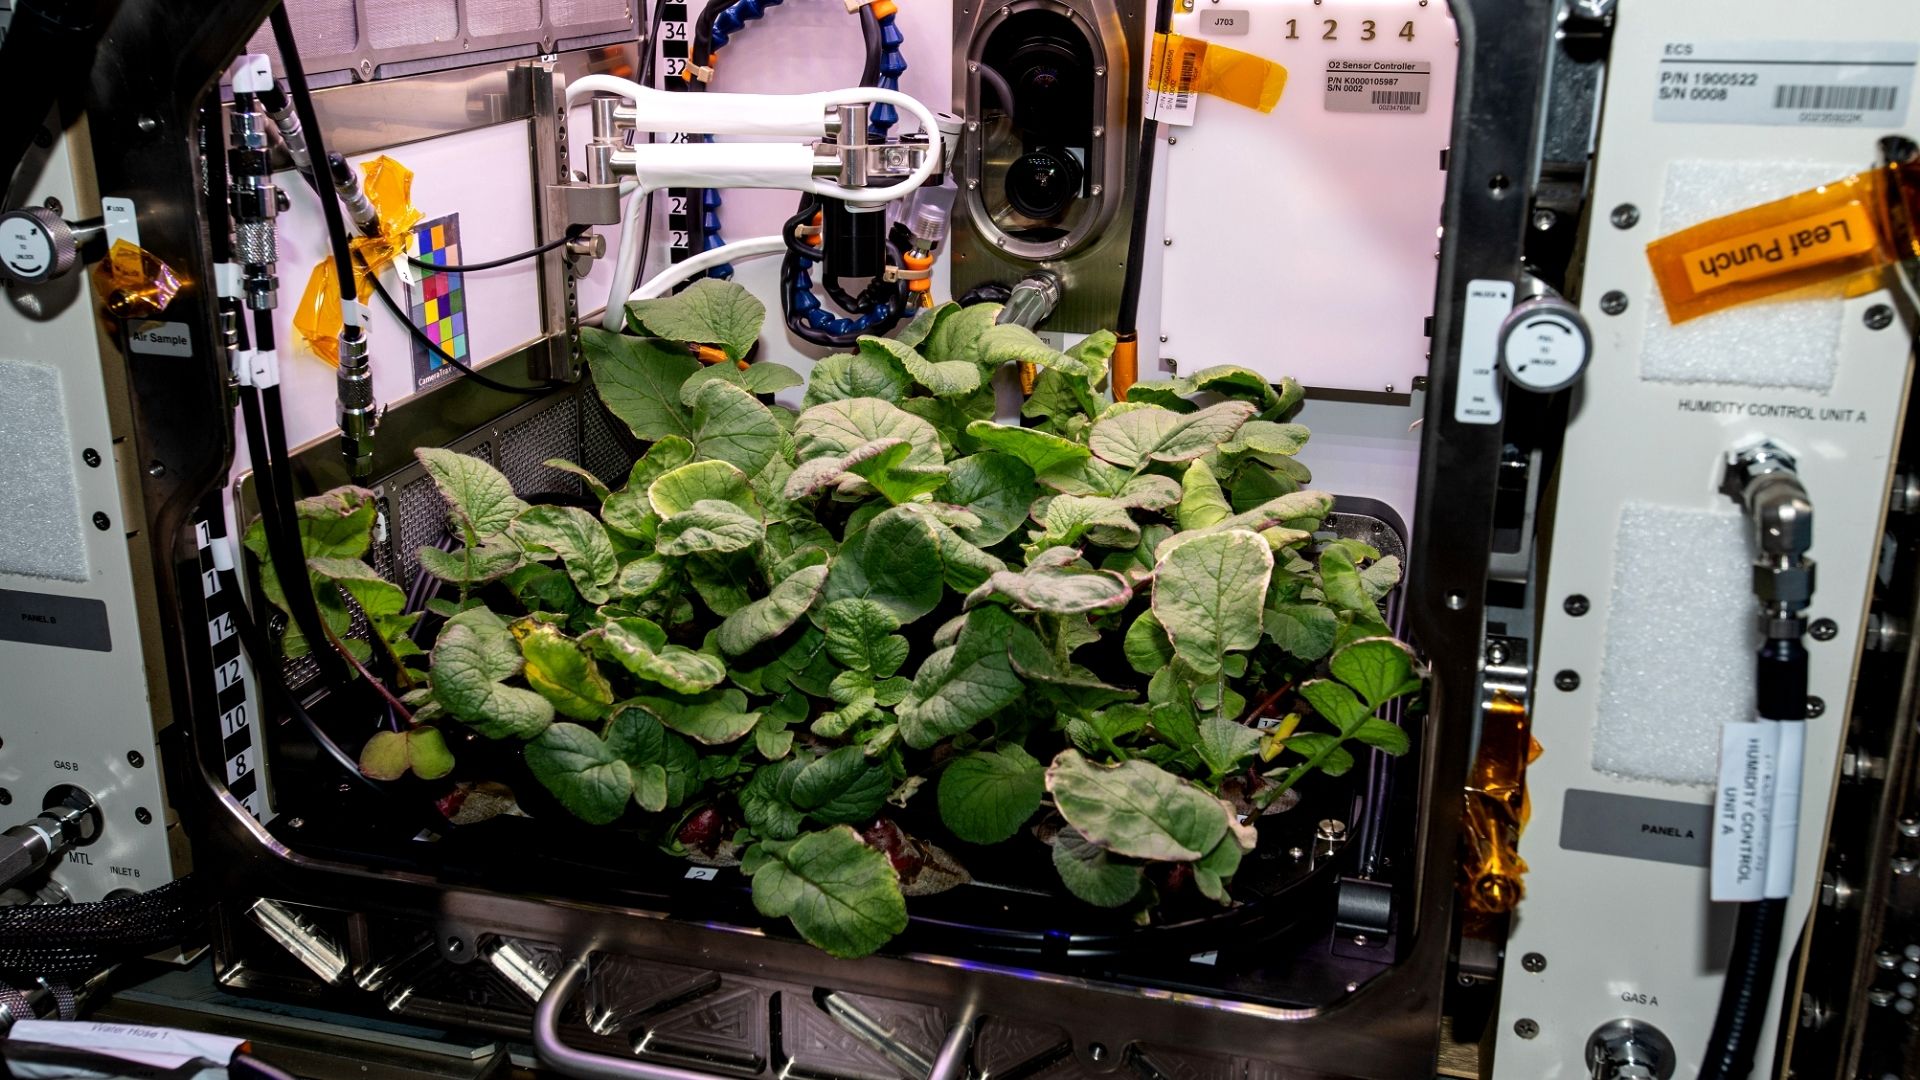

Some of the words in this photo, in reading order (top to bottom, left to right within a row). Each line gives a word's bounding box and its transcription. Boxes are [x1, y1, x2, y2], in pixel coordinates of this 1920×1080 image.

[1214, 18, 1234, 27] J703
[1285, 18, 1299, 40] 1
[1321, 19, 1338, 41] 2
[1360, 20, 1376, 41] 3
[1398, 20, 1415, 42] 4
[665, 22, 686, 40] 34
[1665, 43, 1693, 55] ECS
[666, 58, 686, 76] 32
[1328, 61, 1341, 69] O2
[1342, 62, 1372, 70] Sensor
[1373, 62, 1416, 71] Controller
[1327, 77, 1342, 85] P/N
[1344, 77, 1399, 86] K0000105987
[1660, 72, 1688, 85] P/N
[1694, 73, 1758, 86] 1900522
[1327, 84, 1342, 92] S/N
[1343, 85, 1363, 93] 0002
[1659, 87, 1686, 100] S/N
[1788, 219, 1852, 256] Leaf
[1699, 238, 1784, 277] Punch
[133, 332, 148, 342] Air
[150, 333, 188, 346] Sample
[1678, 400, 1746, 415] HUMIDITY
[1750, 404, 1816, 420] CONTROL
[1819, 409, 1853, 422] UNIT
[1855, 411, 1867, 423] A
[21, 613, 49, 624] PANEL
[213, 613, 235, 641] 14
[219, 659, 241, 687] 12
[225, 705, 246, 733] 10
[54, 760, 71, 770] GAS
[73, 762, 79, 771] B
[236, 754, 247, 776] 8
[1743, 739, 1759, 809] HUMIDITY
[1722, 787, 1737, 820] UNIT
[1641, 824, 1681, 838] PANEL
[1685, 829, 1695, 839] A
[1722, 824, 1735, 835] A
[1737, 812, 1755, 884] CONTROL
[69, 852, 93, 865] MTL
[110, 866, 132, 877] INLET
[134, 869, 141, 878] B
[1621, 991, 1647, 1005] GAS
[1649, 995, 1659, 1006] A
[127, 1027, 158, 1038] Hose
